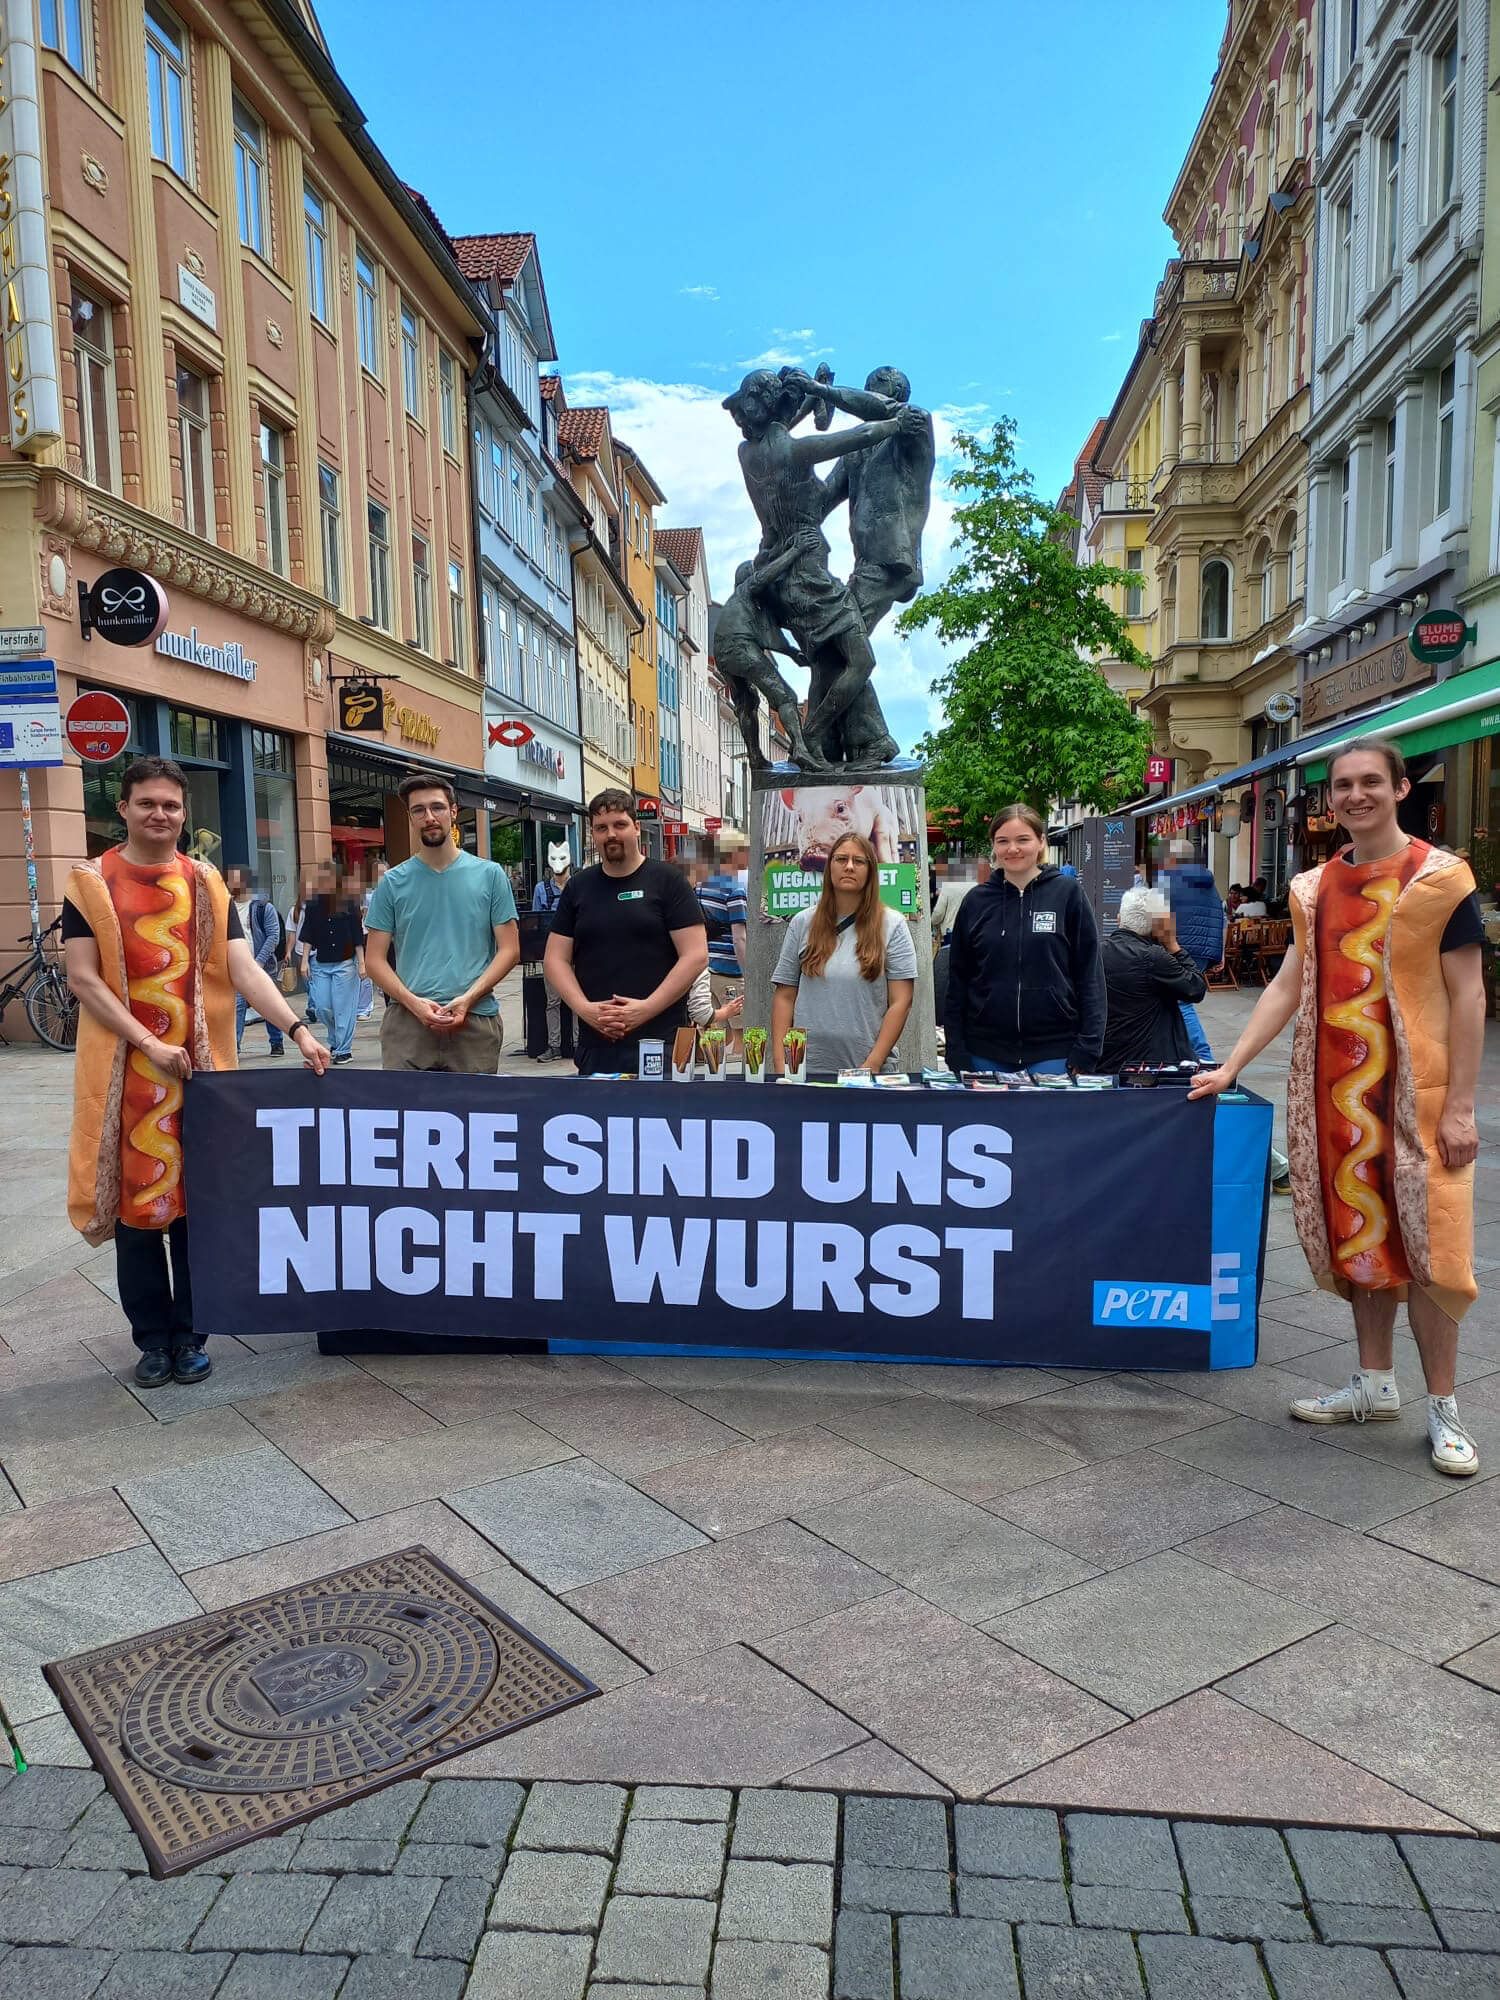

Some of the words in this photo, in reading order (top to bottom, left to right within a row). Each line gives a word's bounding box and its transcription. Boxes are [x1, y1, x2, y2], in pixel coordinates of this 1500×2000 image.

[97, 613, 155, 626] hunkemöller
[1419, 623, 1463, 635] BLUME
[1422, 634, 1459, 645] 2000
[157, 627, 258, 682] hunkemöller
[1150, 760, 1164, 777] T
[879, 869, 898, 886] ET
[256, 1107, 519, 1191] TIERE
[542, 1113, 776, 1198] SIND
[801, 1121, 1013, 1209] UNS
[258, 1205, 581, 1301] NICHT
[604, 1215, 1013, 1321] WURST
[289, 1629, 411, 1667] GÖTTINGEN
[350, 1671, 409, 1716] STADT
